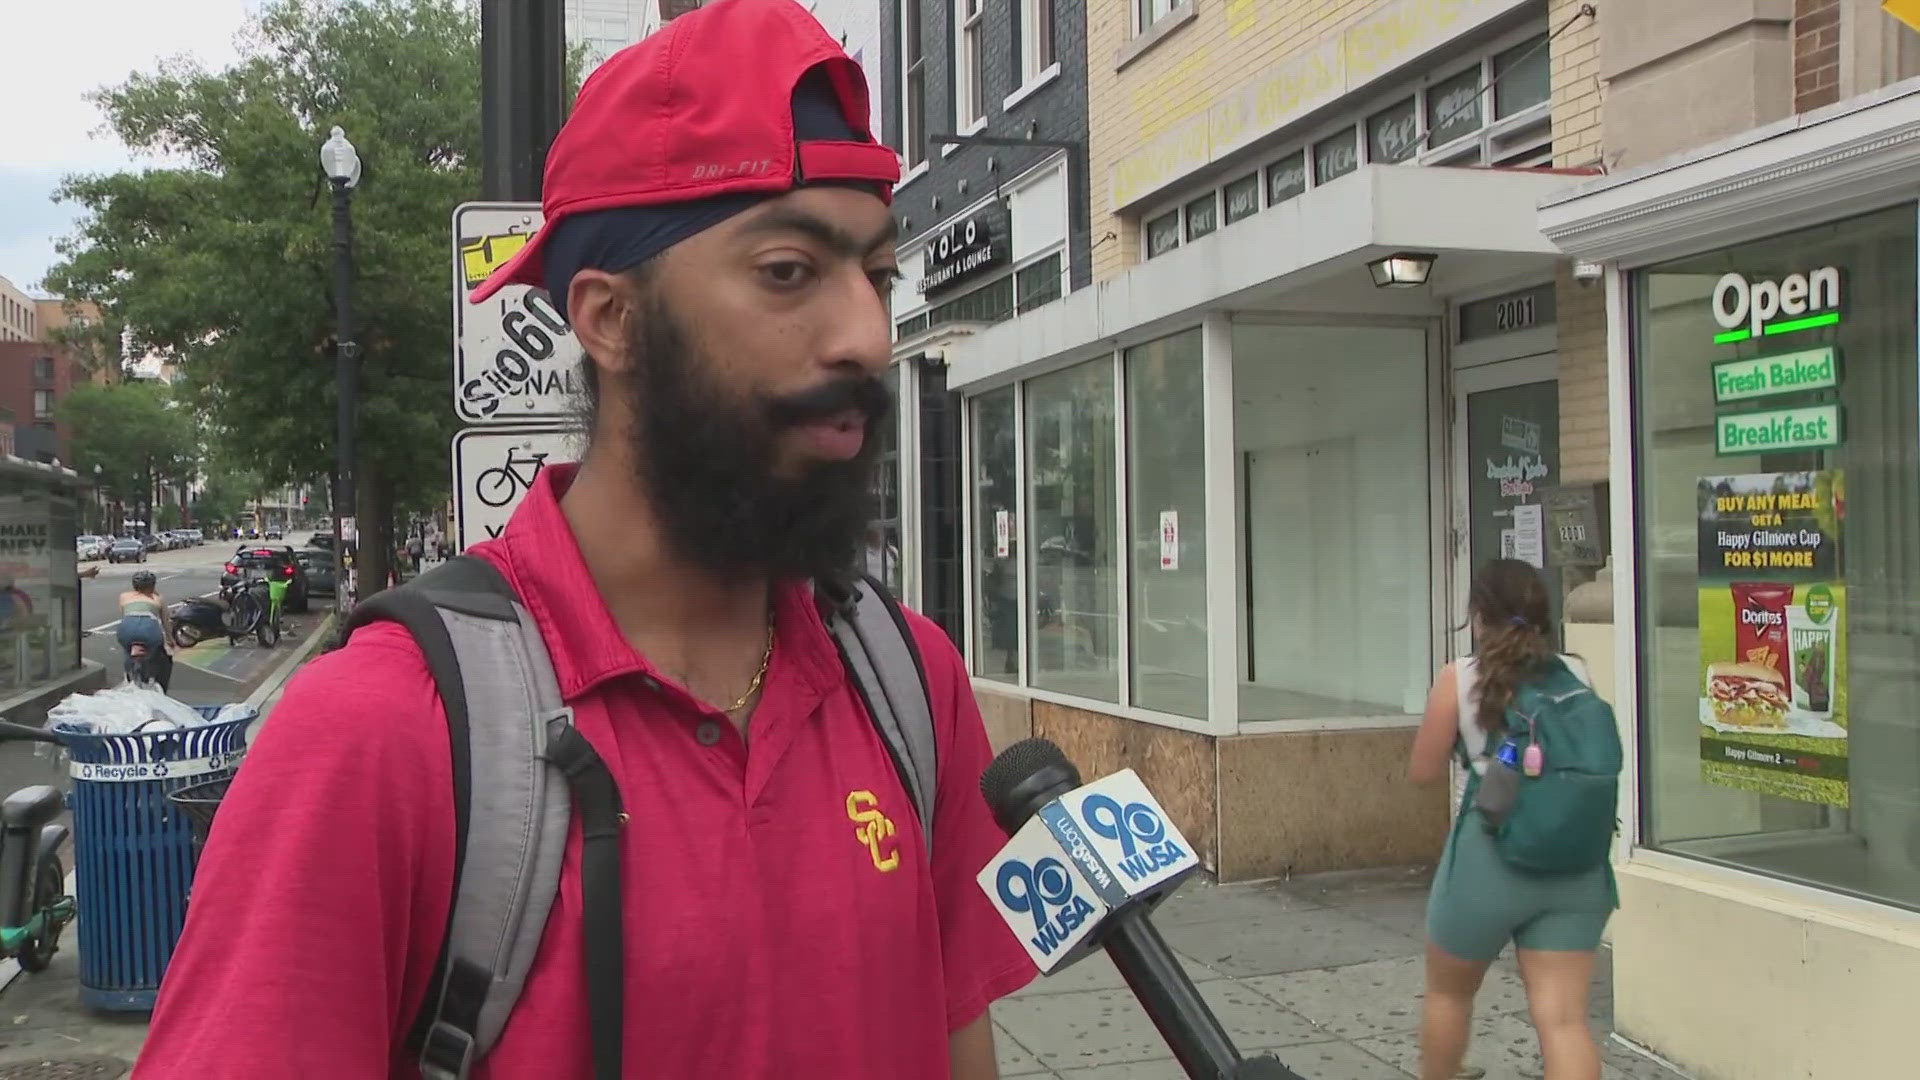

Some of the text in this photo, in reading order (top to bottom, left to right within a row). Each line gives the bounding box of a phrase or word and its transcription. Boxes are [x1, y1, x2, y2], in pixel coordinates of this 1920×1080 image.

[693, 159, 771, 179] DRI-FIT
[928, 219, 976, 266] YOLO
[962, 245, 993, 272] LOUNGE
[1712, 266, 1841, 338] Open
[1498, 297, 1535, 329] 2001
[1717, 354, 1832, 395] Fresh Baked
[1724, 415, 1828, 447] Breakfast
[1717, 493, 1819, 512] BUY ANY MEAL
[1751, 514, 1783, 527] GET A
[1561, 526, 1584, 541] 2001
[1717, 529, 1820, 548] Happy Gilmore Cup
[1724, 551, 1814, 568] FOR $1 MORE
[1741, 608, 1783, 625] Doritos
[1794, 630, 1829, 652] HAPPY
[1725, 746, 1746, 760] Happy
[1747, 749, 1775, 764] Gilmore
[1775, 753, 1782, 765] 2
[95, 765, 148, 780] Recycle
[1117, 839, 1187, 882] WUSA
[1031, 895, 1096, 957] WUSA
